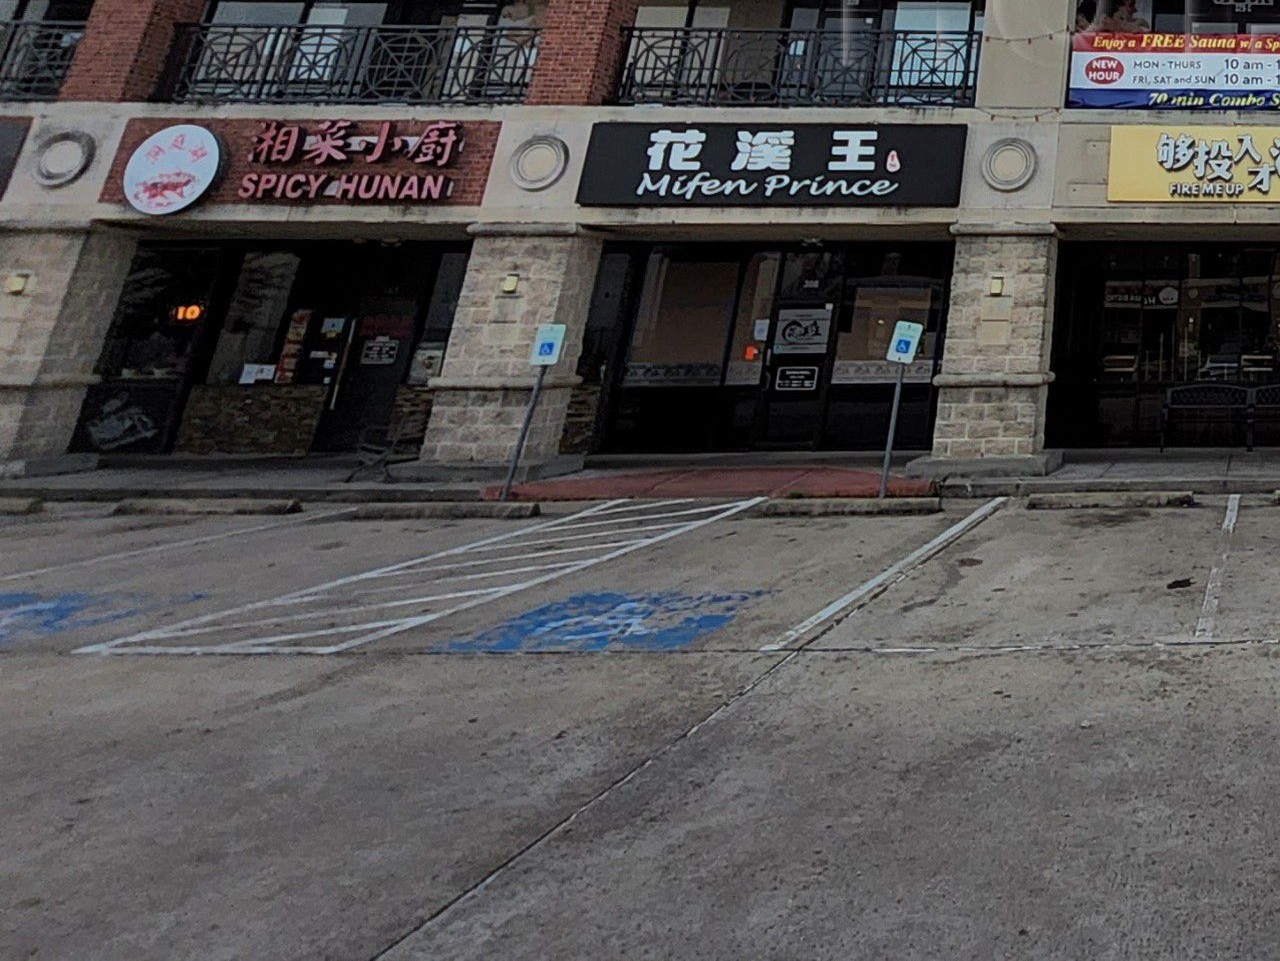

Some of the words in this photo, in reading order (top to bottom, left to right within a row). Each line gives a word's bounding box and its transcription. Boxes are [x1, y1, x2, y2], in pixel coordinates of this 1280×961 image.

[1093, 36, 1125, 50] Enjoy
[1128, 39, 1136, 48] a
[1141, 33, 1185, 48] FREE
[1189, 35, 1236, 49] Sauna
[1254, 40, 1262, 48] a
[1092, 59, 1119, 69] NEW
[1133, 61, 1160, 69] MON
[1168, 61, 1202, 69] THURS
[1224, 59, 1239, 70] 10
[1243, 61, 1264, 70] am
[1088, 71, 1120, 81] HOUR
[1132, 76, 1150, 85] FRI,
[1153, 76, 1172, 84] SAT
[1174, 76, 1191, 84] and
[1195, 76, 1216, 84] SUN
[1224, 74, 1239, 85] 10
[1243, 76, 1263, 85] am
[1209, 93, 1265, 106] Combo
[645, 129, 878, 171] 花溪王
[237, 174, 328, 199] SPICY
[334, 174, 444, 200] HUNAN
[636, 171, 759, 200] Mifen
[762, 173, 900, 197] Prince
[1170, 183, 1200, 195] FIRE
[1202, 183, 1223, 195] ME
[1226, 183, 1245, 195] UP
